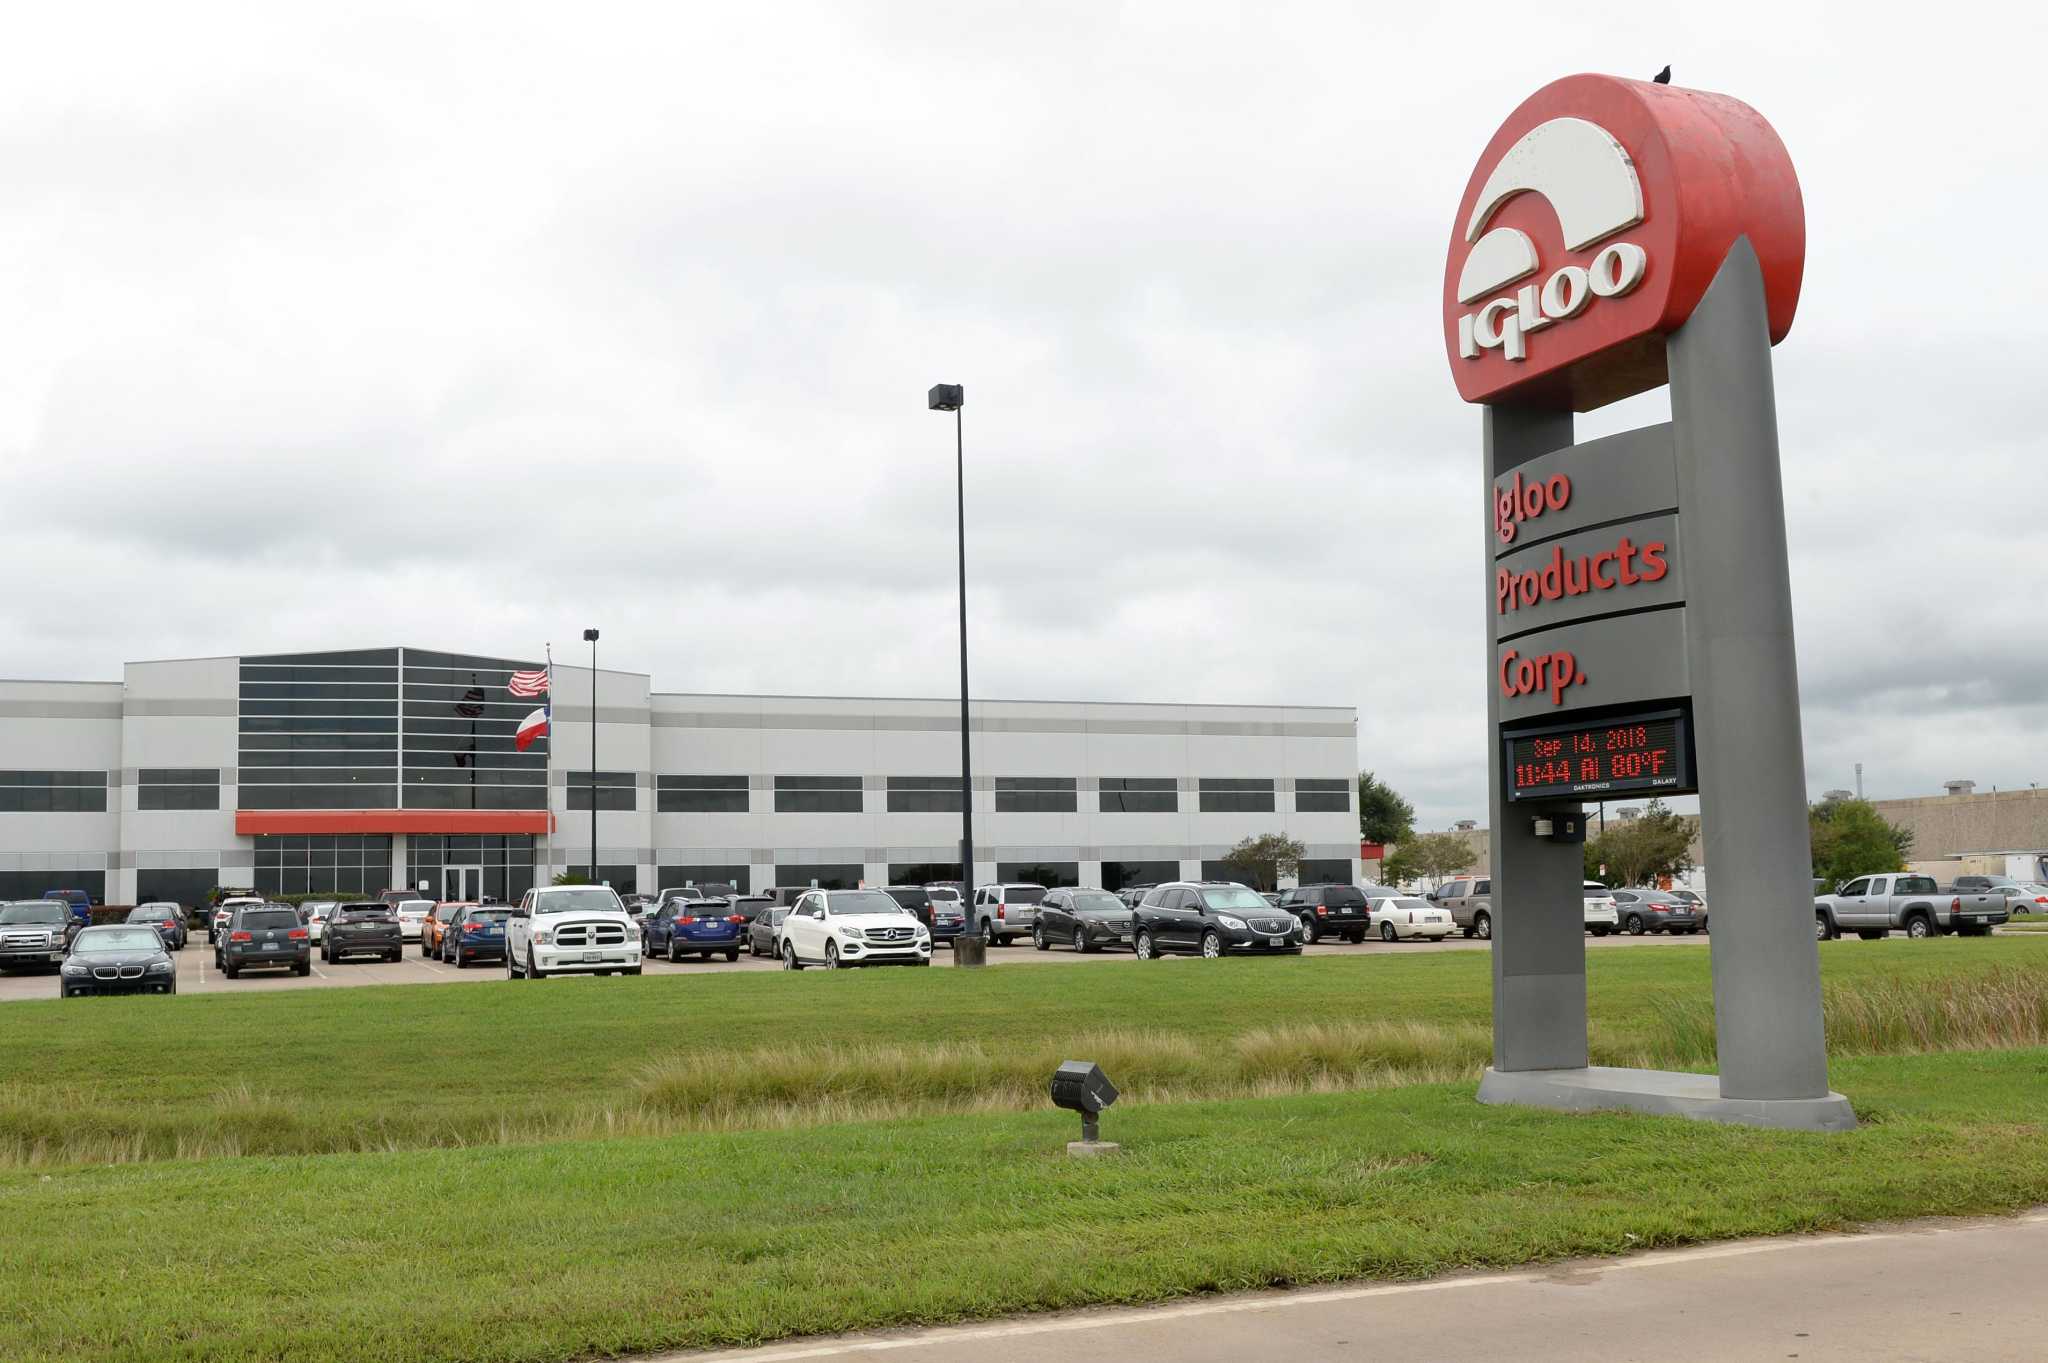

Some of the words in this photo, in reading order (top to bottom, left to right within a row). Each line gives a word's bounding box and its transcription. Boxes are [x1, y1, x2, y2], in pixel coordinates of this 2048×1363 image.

[1494, 471, 1571, 544] Igloo
[1496, 536, 1668, 615] Products
[1501, 648, 1588, 705] Corp.
[1606, 726, 1646, 751] 2018
[1515, 760, 1571, 787] 11:44
[1573, 782, 1610, 791] DAKTRONICS
[1652, 777, 1677, 785] GALAXY
